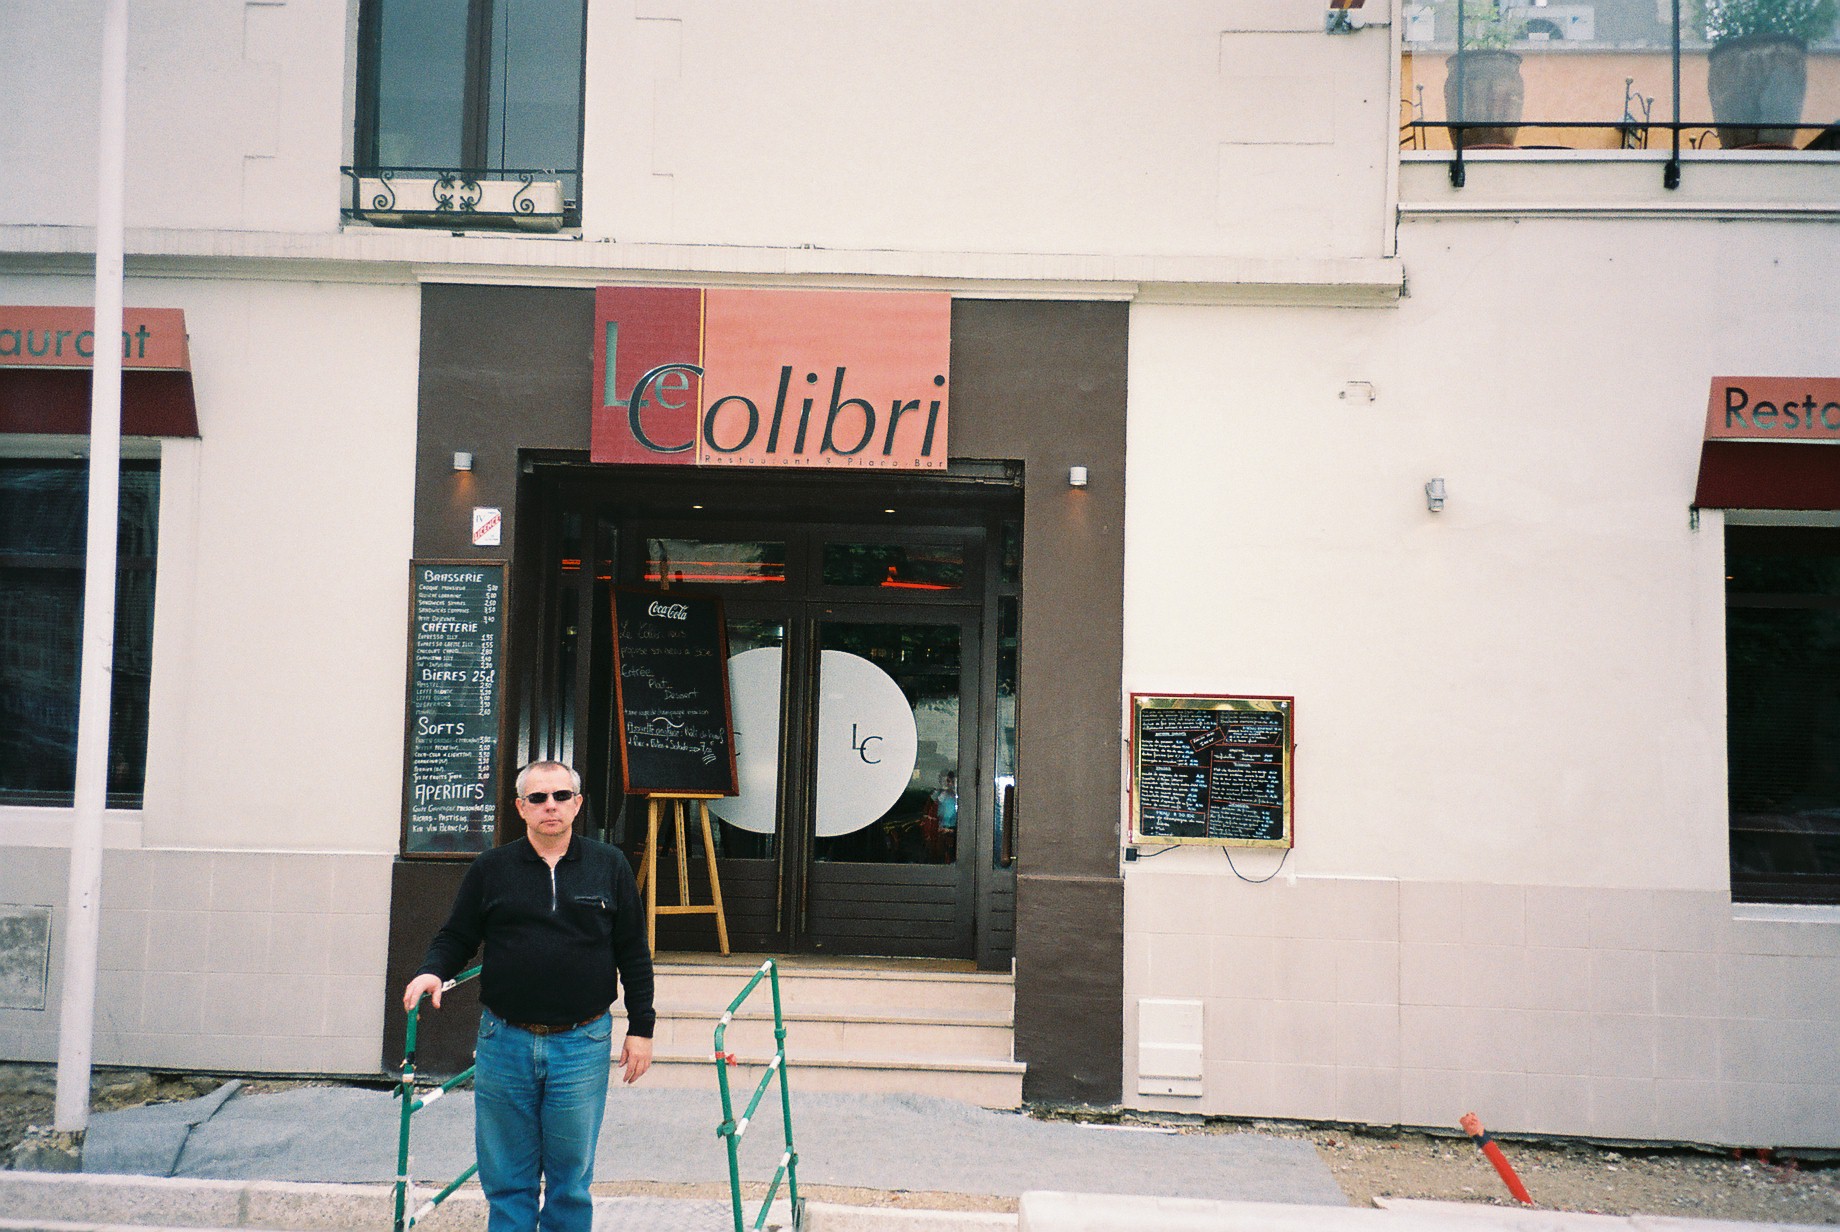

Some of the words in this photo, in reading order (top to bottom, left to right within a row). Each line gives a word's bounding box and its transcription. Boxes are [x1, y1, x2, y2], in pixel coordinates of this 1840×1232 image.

[603, 321, 689, 409] Le
[628, 363, 945, 456] Colibri
[648, 601, 689, 620] Coca-Cola
